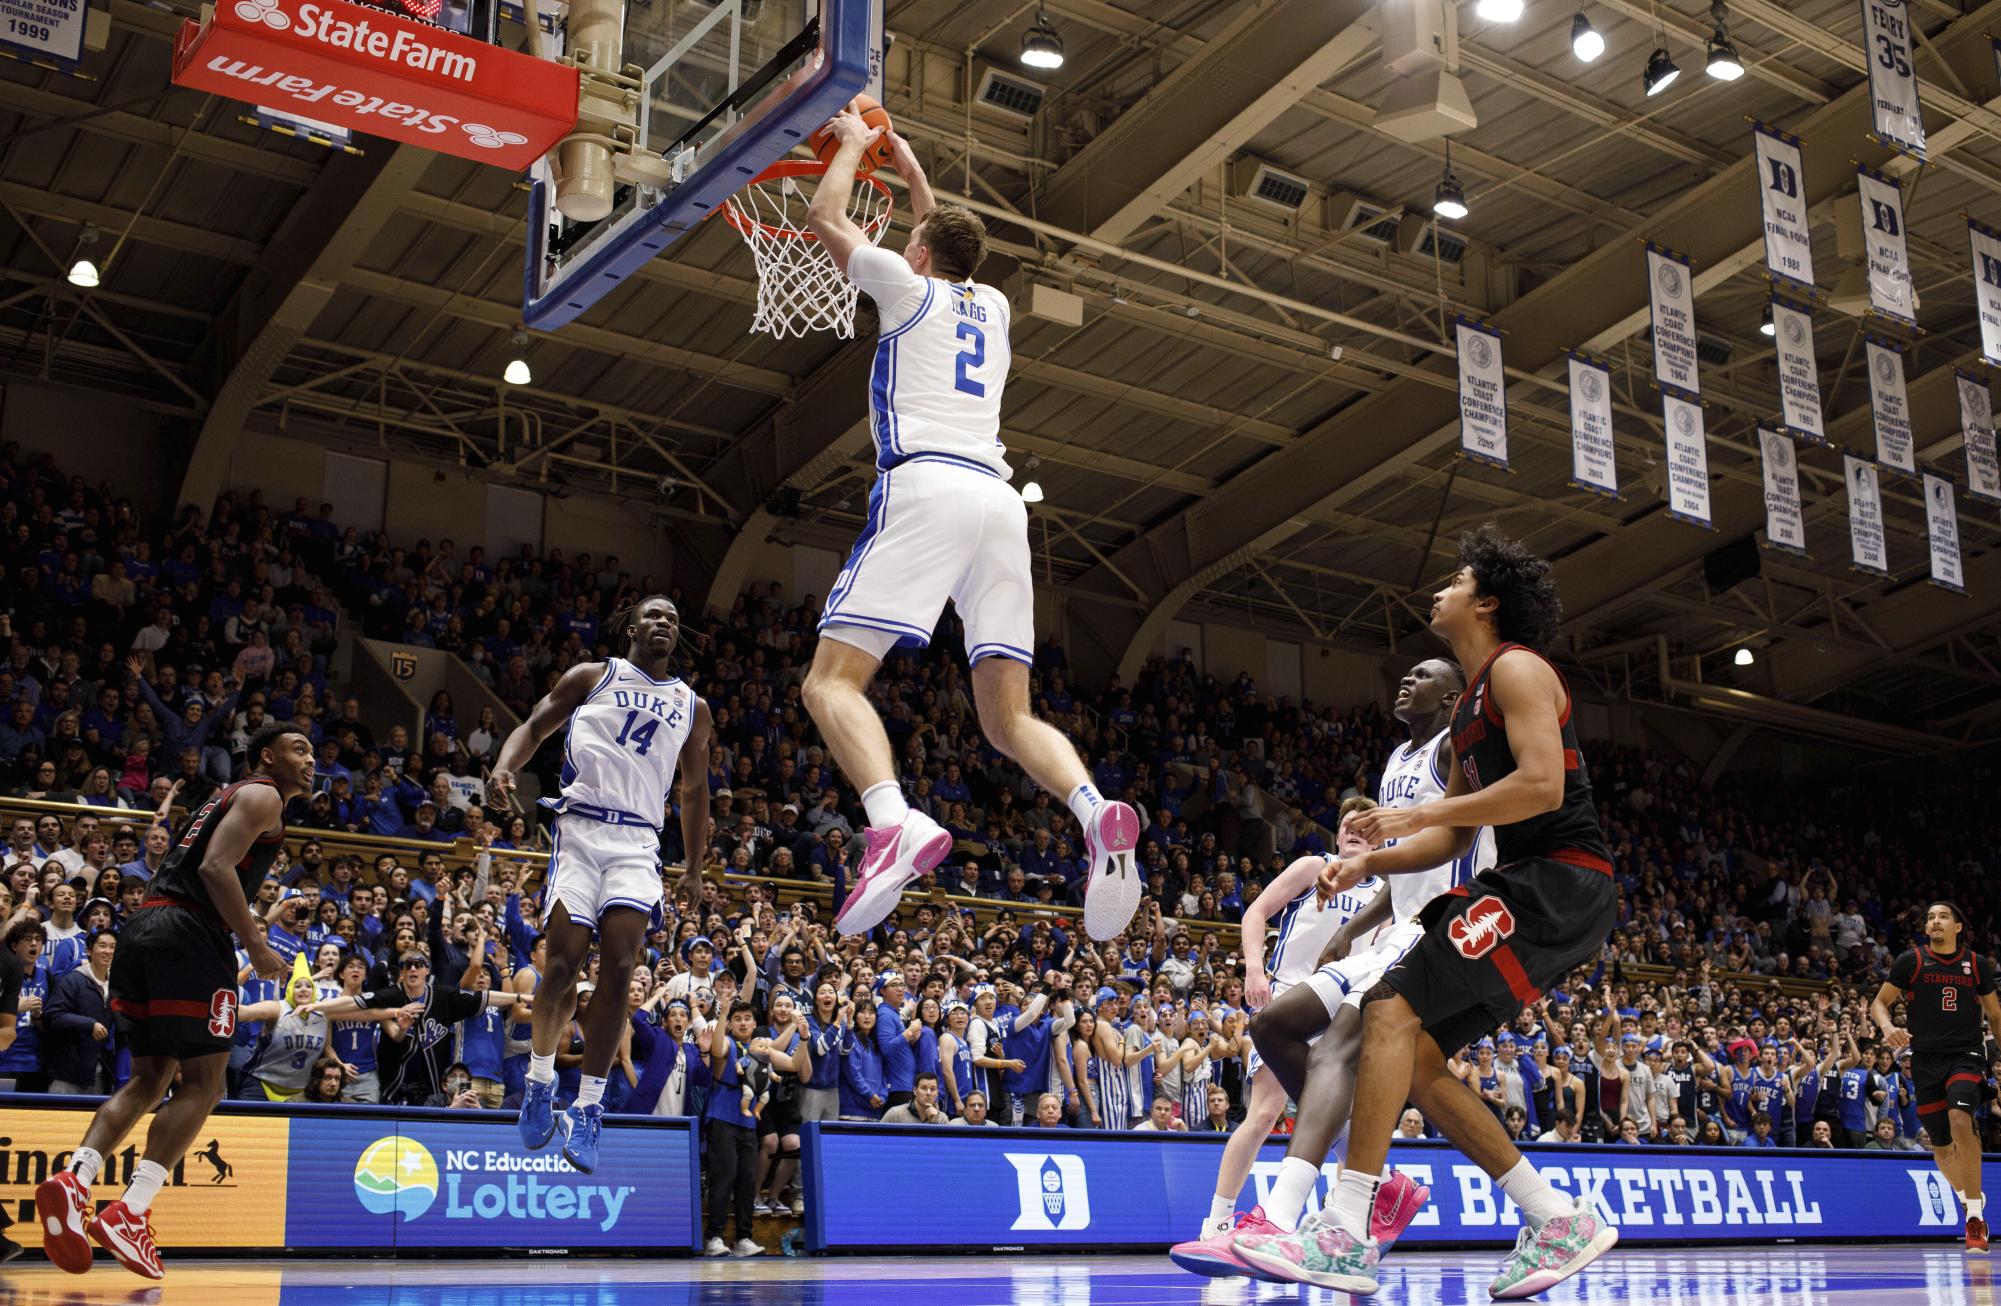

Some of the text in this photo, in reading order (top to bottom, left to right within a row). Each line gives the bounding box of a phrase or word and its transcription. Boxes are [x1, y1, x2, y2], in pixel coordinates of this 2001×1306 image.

[36, 5, 70, 20] SEASON
[9, 18, 49, 41] 1999
[1876, 34, 1911, 78] 35
[1776, 208, 1797, 224] NCAA
[1766, 222, 1789, 239] FINAL
[1879, 246, 1899, 262] NCAA
[1660, 304, 1687, 322] ATLANTIC
[1982, 312, 1999, 327] FINAL
[1664, 317, 1684, 332] COAST
[1656, 326, 1695, 349] CONFERENCE
[1658, 339, 1694, 360] CHAMPIONS
[955, 321, 985, 398] 2
[1785, 353, 1810, 371] ATLANTIC
[1790, 366, 1808, 379] COAST
[1467, 375, 1498, 392] ATLANTIC
[1782, 374, 1819, 394] CONFERENCE
[1474, 389, 1493, 402] COAST
[1785, 386, 1819, 404] CHAMPIONS
[1462, 396, 1504, 417] CONFERENCE
[1584, 422, 1602, 435] COAST
[1574, 430, 1613, 449] CONFERENCE
[1576, 442, 1612, 460] CHAMPIONS
[1674, 442, 1700, 457] ATLANTIC
[1679, 454, 1697, 466] COAST
[1670, 462, 1707, 480] CONFERENCE
[1672, 474, 1706, 491] CHAMPIONS
[395, 659, 414, 677] 15
[614, 691, 683, 728] DUKE
[615, 710, 660, 756] 14
[1327, 893, 1367, 914] DUK
[1923, 974, 1973, 987] STANFORD
[1942, 986, 1957, 1011] 2
[487, 1015, 494, 1032] 1
[283, 1034, 323, 1050] DUKE
[351, 1031, 358, 1050] 1
[1668, 1071, 1691, 1082] Duke
[1702, 1092, 1711, 1107] 2
[1739, 1093, 1745, 1105] 1
[1759, 1097, 1769, 1111] 2
[447, 1150, 479, 1171] NC
[446, 1173, 630, 1232] Lottery
[1452, 1164, 1823, 1226] BSKETBALL
